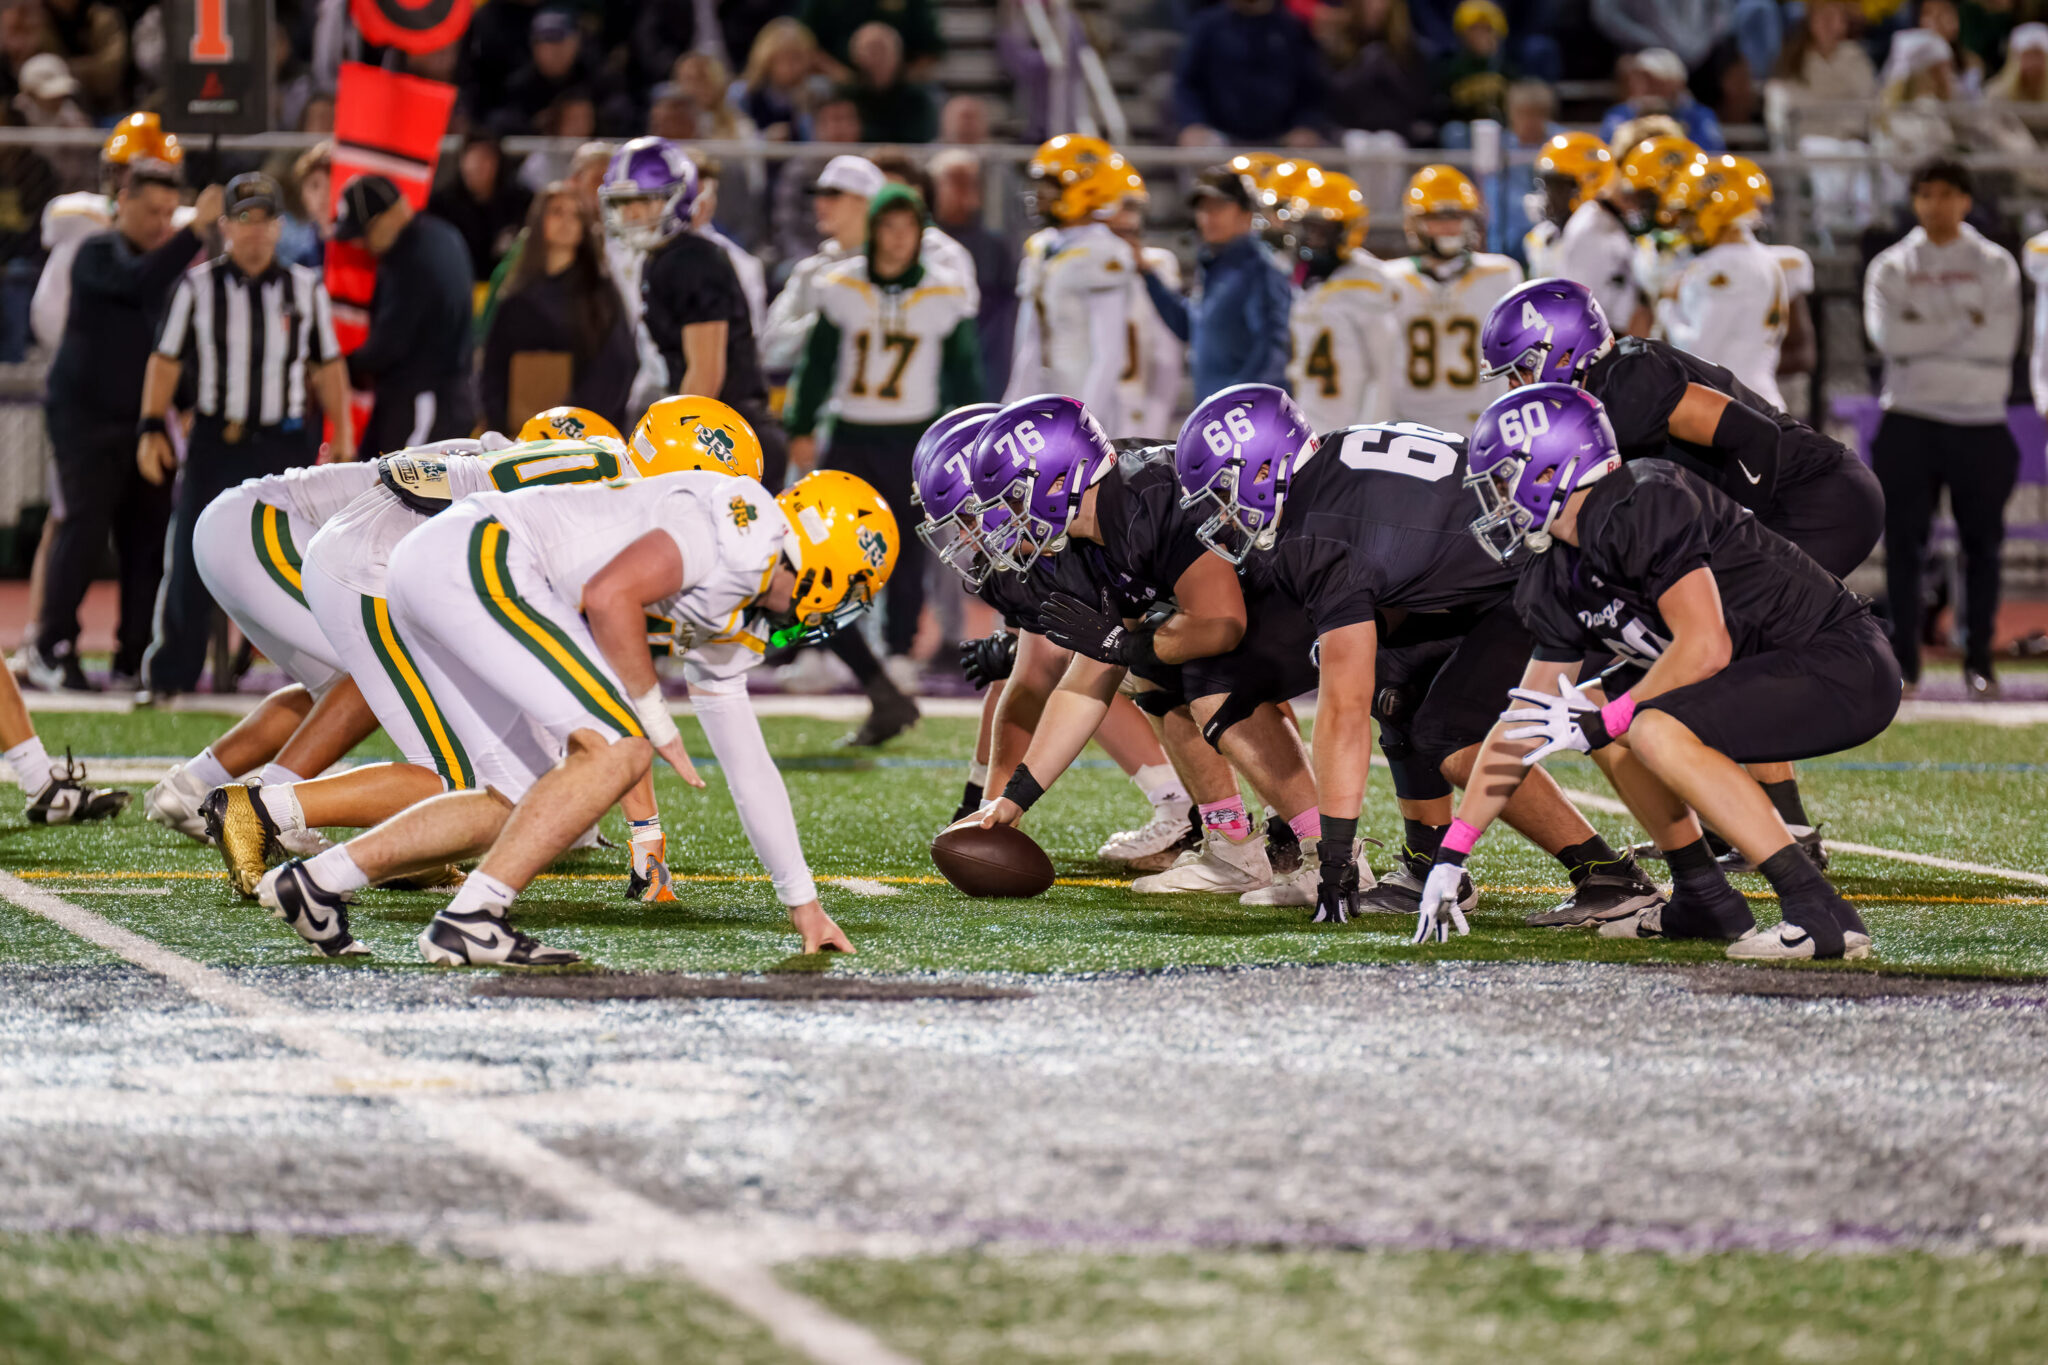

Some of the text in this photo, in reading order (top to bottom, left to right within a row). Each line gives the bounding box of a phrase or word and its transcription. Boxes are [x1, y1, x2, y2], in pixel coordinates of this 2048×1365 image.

[1522, 301, 1547, 331] 4
[850, 330, 921, 399] 17
[1408, 315, 1478, 389] 83
[993, 420, 1046, 468] 76
[1202, 407, 1256, 457] 66
[1499, 401, 1550, 447] 60
